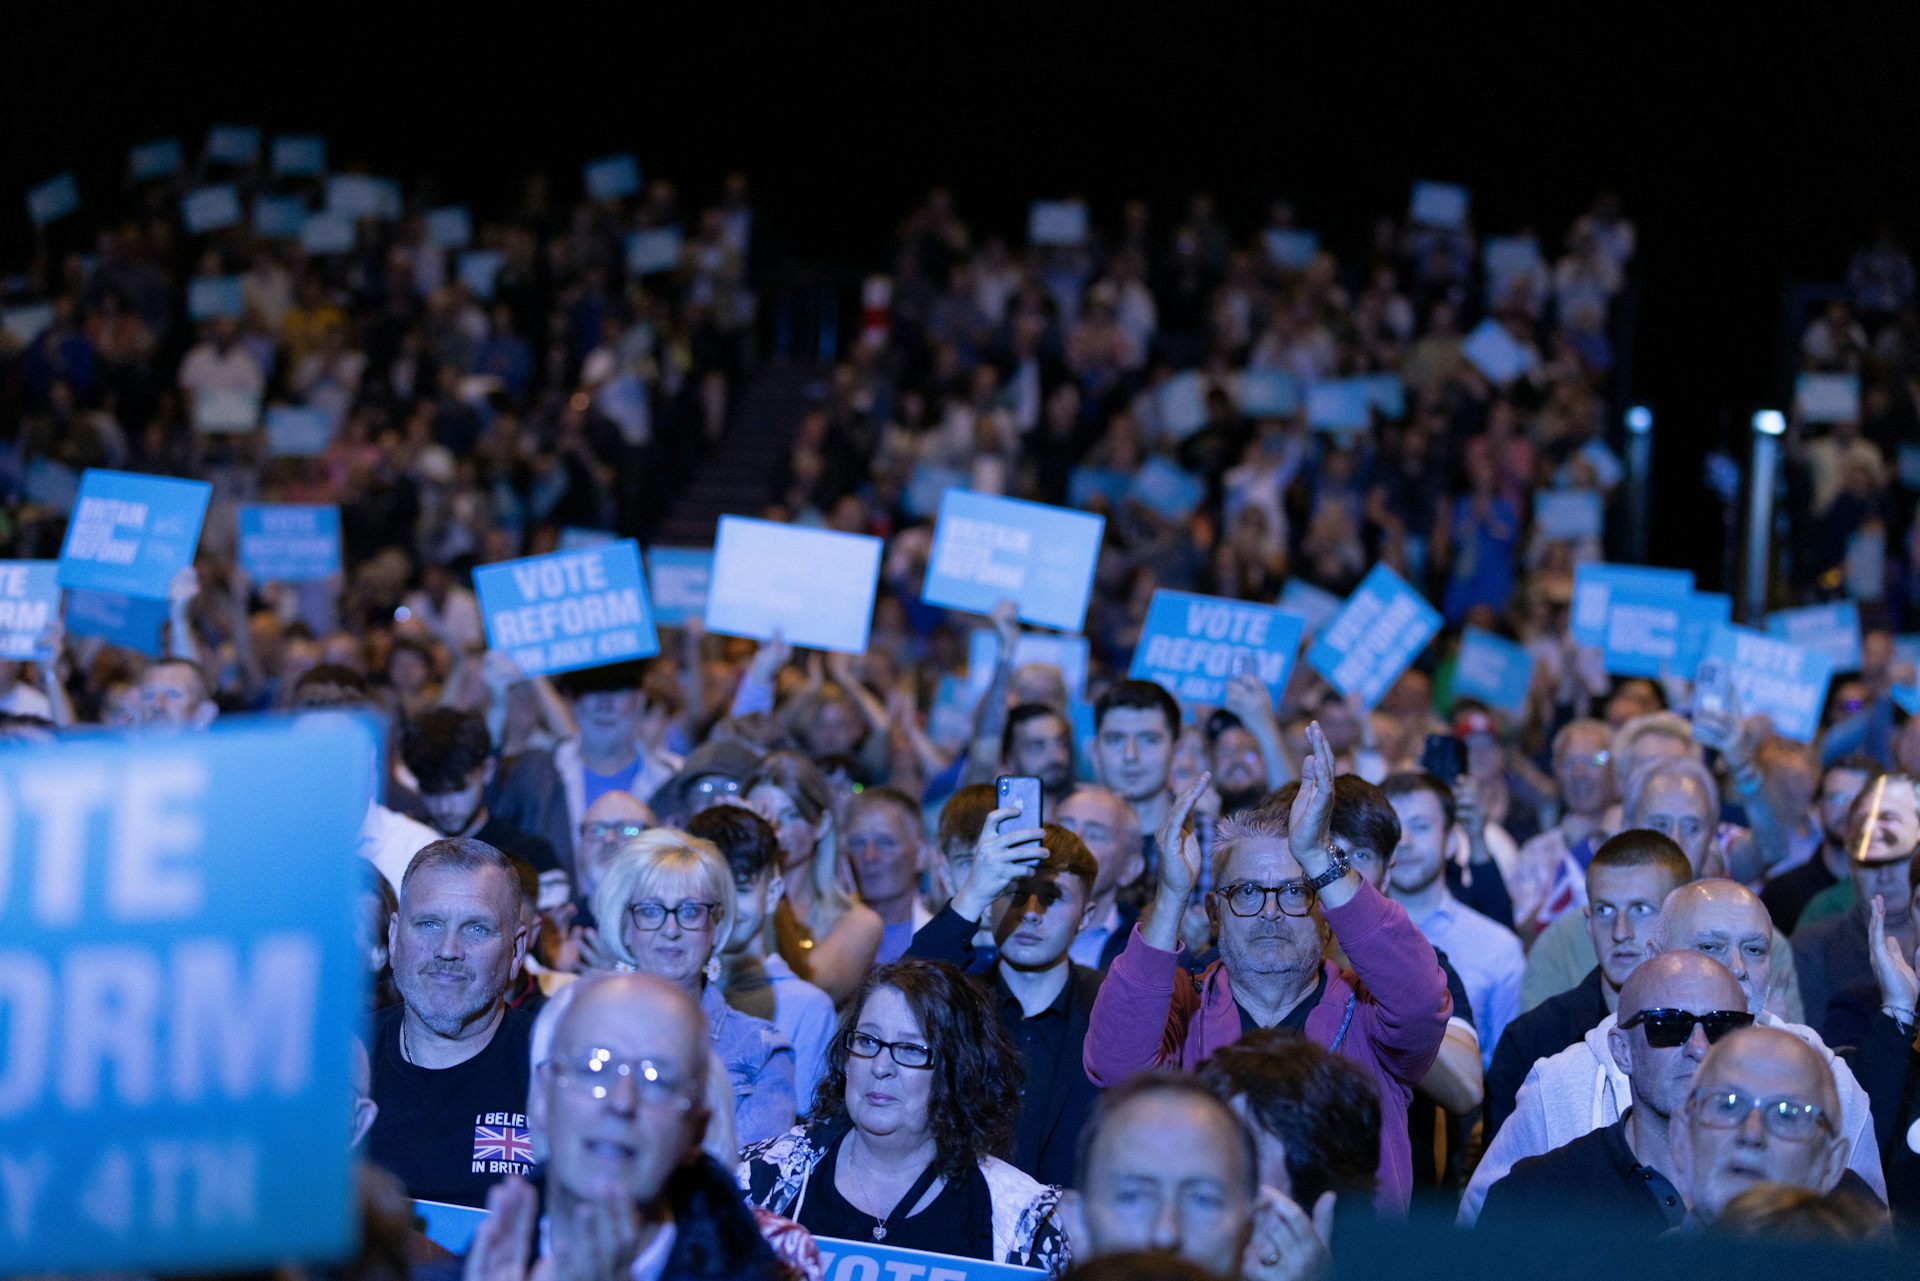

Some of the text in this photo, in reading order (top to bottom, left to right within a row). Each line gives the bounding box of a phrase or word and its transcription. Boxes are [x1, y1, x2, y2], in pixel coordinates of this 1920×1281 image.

[513, 552, 608, 601] VOTE
[494, 588, 643, 650] REFORM
[1187, 602, 1271, 646] VOTE
[1145, 634, 1284, 685] REFOM
[0, 758, 203, 926] TE
[476, 1114, 481, 1125] I
[472, 1161, 486, 1173] IN
